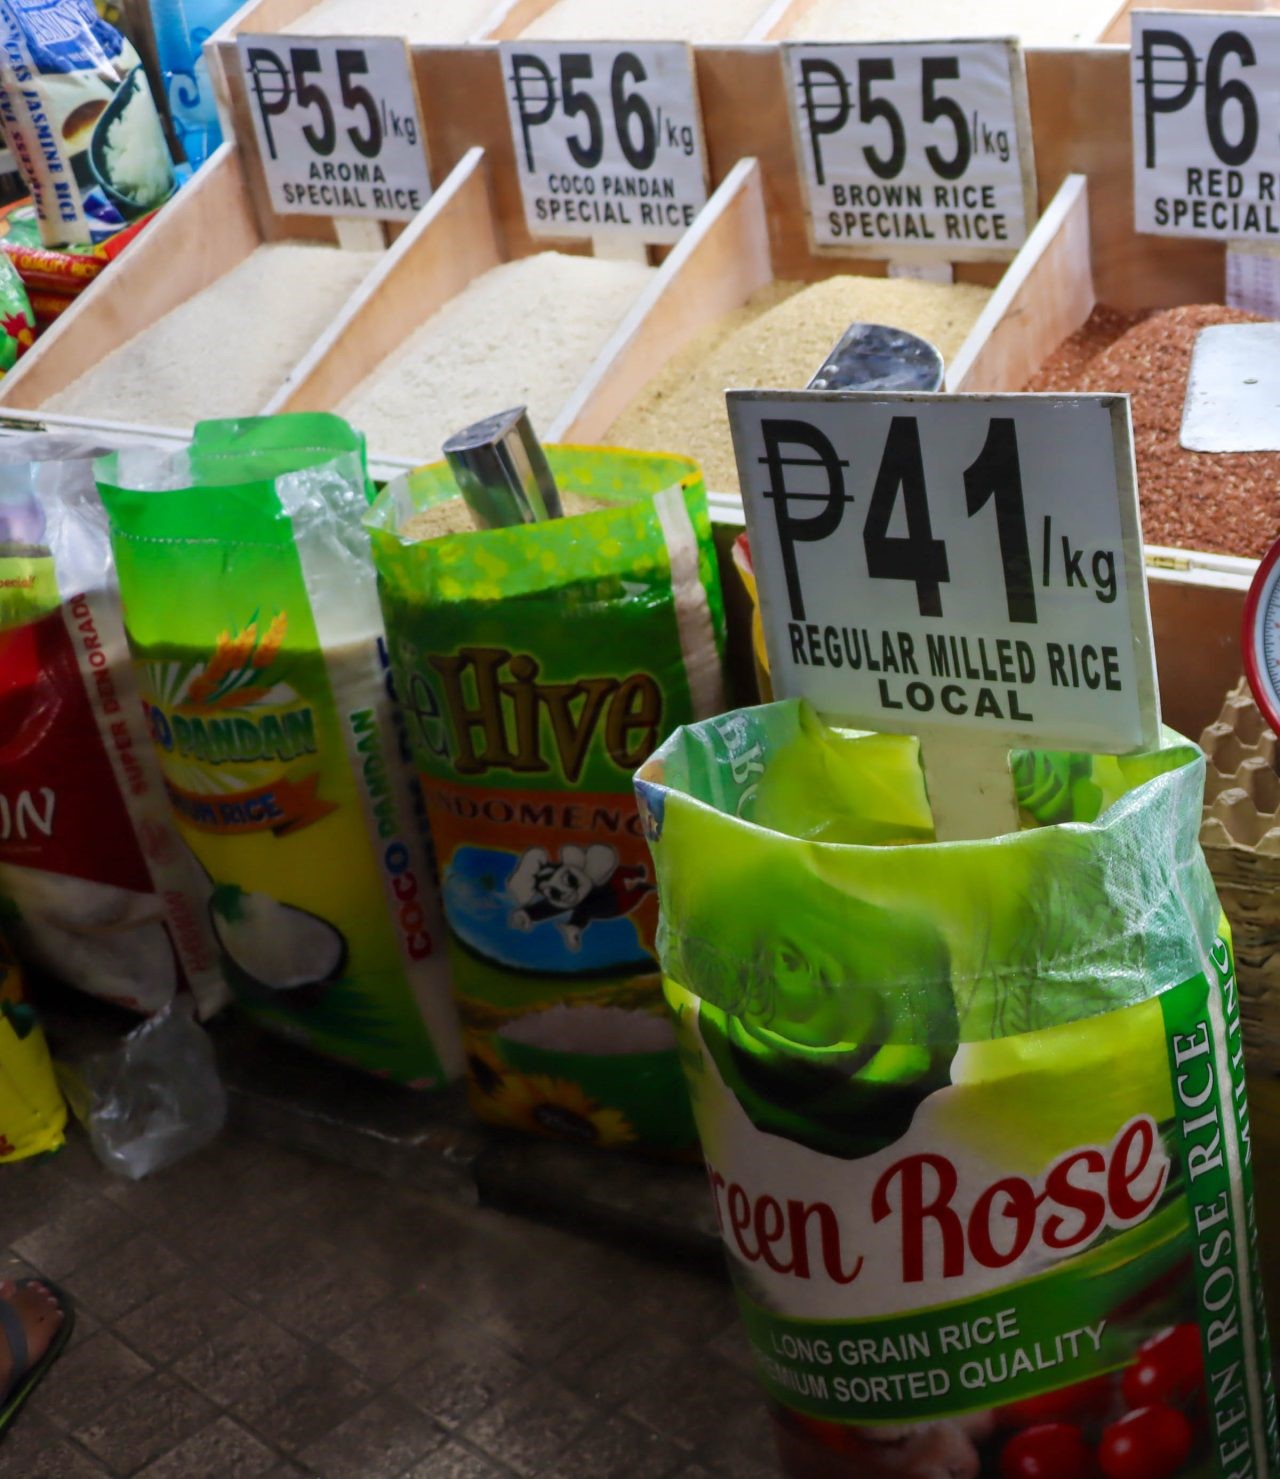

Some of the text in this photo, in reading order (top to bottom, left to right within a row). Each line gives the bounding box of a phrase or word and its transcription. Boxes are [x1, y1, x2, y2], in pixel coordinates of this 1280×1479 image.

[22, 90, 64, 173] JASMINE
[54, 182, 78, 222] RICE
[309, 161, 386, 183] AROMA
[1186, 167, 1243, 198] RED
[283, 183, 422, 211] SPECIAL RICE
[535, 198, 695, 227] SPECIAL RICE
[549, 174, 675, 197] COCO PANDAN
[833, 185, 996, 209] BROWN RICE
[829, 212, 1008, 240] SPECIAL RICE
[1154, 198, 1280, 234] SPECIAL
[788, 622, 1122, 691] REGULAR MILLED RICE
[879, 679, 1034, 722] LOCAL
[110, 720, 148, 796] SUPER
[172, 708, 317, 764] PANDAN
[349, 709, 400, 839] PANDAN
[220, 792, 284, 824] RICE
[384, 842, 432, 960] COCO
[1173, 1021, 1224, 1182] RICE
[872, 1119, 1167, 1283] Rose
[1195, 1190, 1240, 1354] ROSE
[769, 1308, 1020, 1366] LONG GRAIN RICE
[833, 1367, 950, 1403] SORTED
[958, 1319, 1107, 1389] QUALITY
